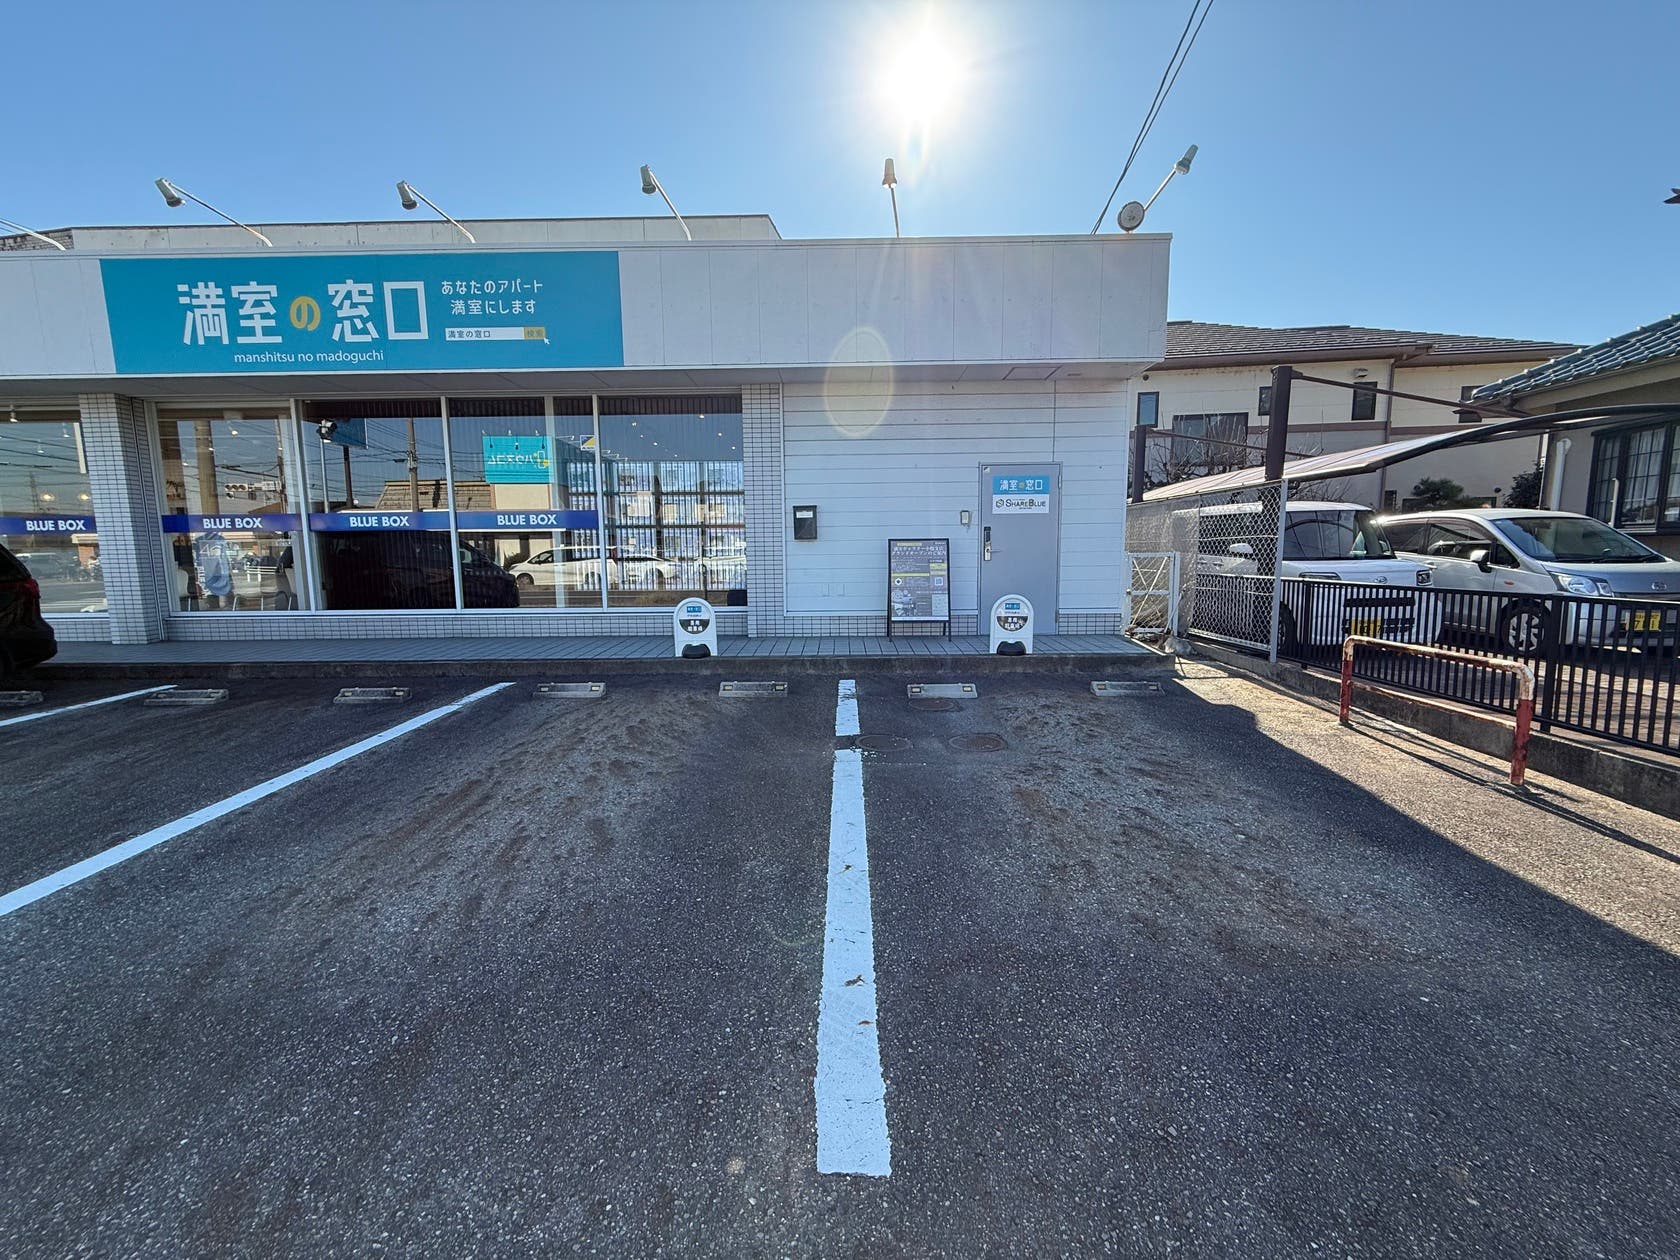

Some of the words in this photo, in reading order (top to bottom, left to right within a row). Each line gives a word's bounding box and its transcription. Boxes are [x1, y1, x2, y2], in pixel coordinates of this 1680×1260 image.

[441, 278, 543, 295] あなたのアパート
[177, 279, 429, 345] 満室の窓口
[450, 299, 536, 315] 満室にします
[447, 330, 491, 339] 満室の窓口
[234, 353, 295, 363] manshitsu
[299, 354, 314, 363] no
[317, 350, 384, 365] madoguchi
[26, 520, 56, 531] BLUE
[58, 519, 87, 531] BOX
[203, 518, 232, 529] BLUE
[235, 517, 263, 529] BOX
[349, 516, 379, 527] BLUE
[382, 516, 410, 527] BOX
[497, 515, 526, 525] BLUE
[530, 514, 558, 525] BOX
